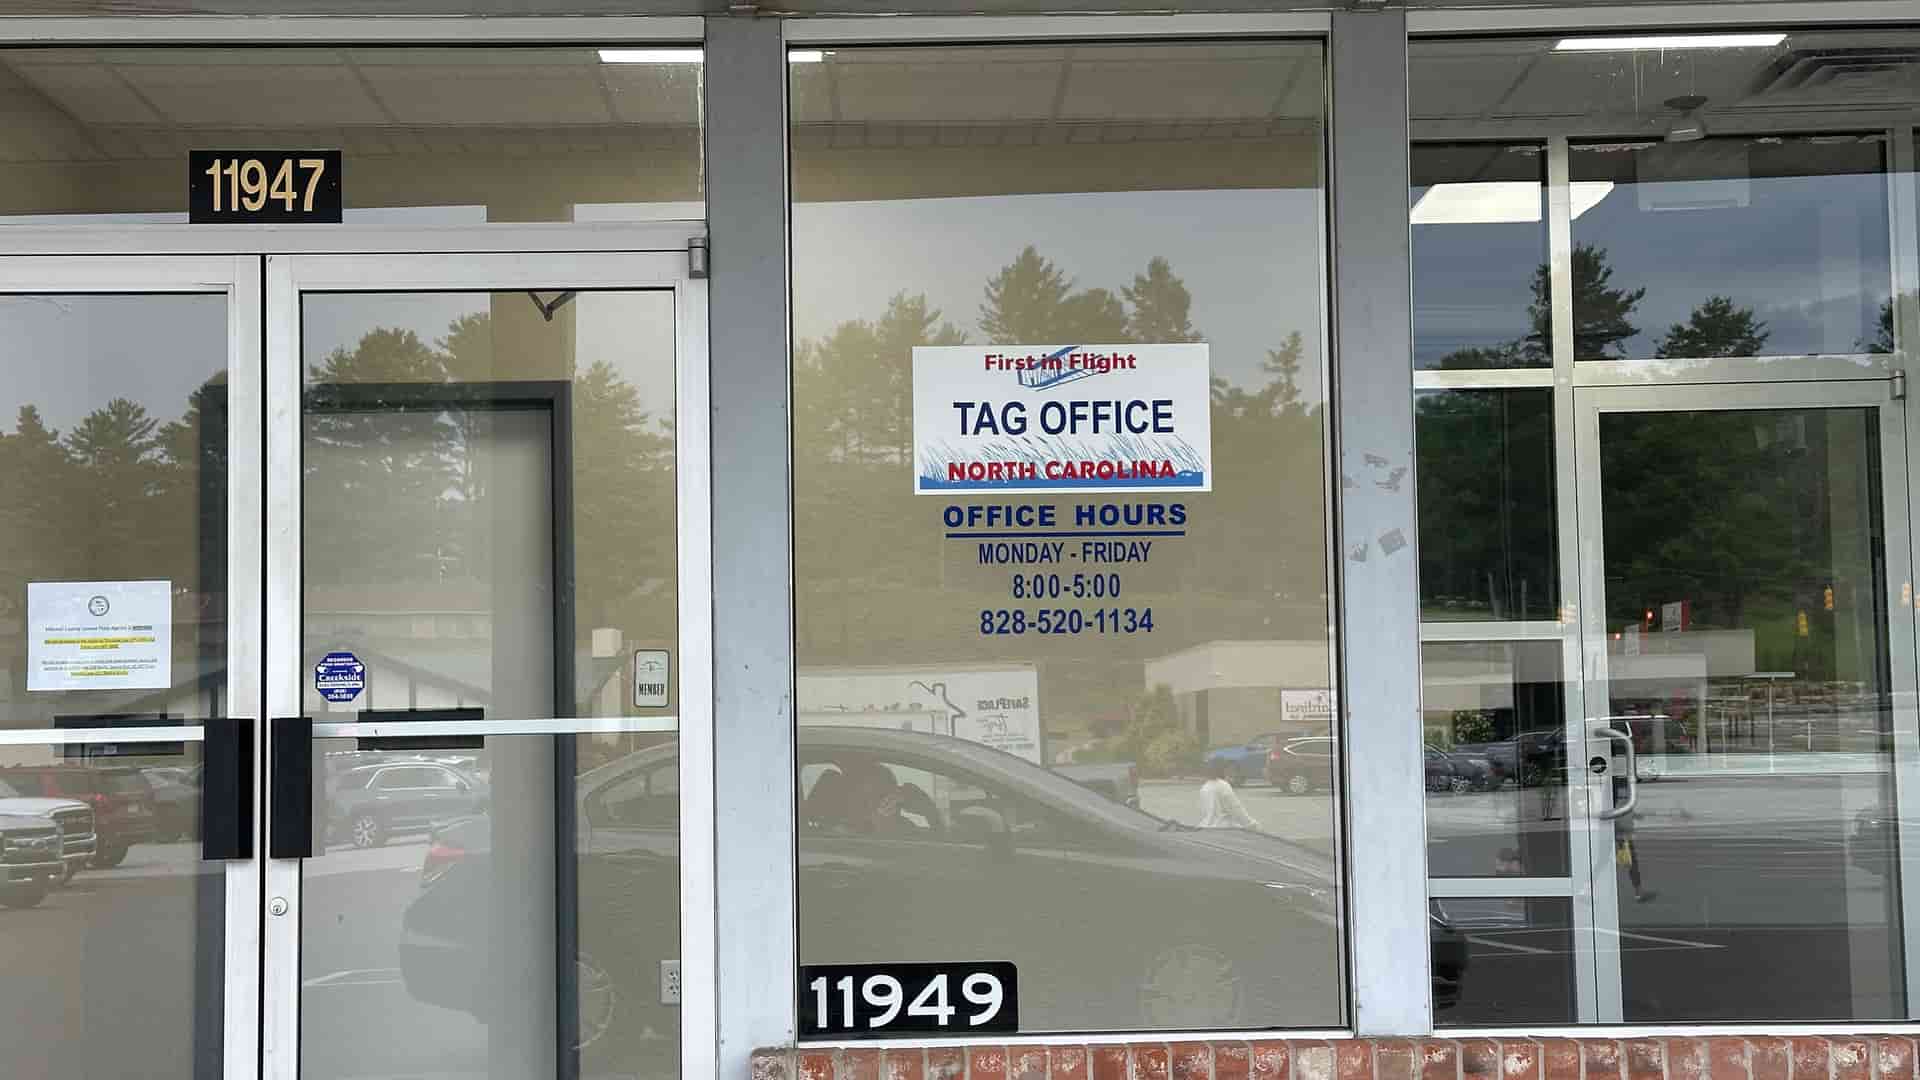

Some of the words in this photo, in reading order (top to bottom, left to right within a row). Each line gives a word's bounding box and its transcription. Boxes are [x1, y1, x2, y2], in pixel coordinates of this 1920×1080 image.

[205, 158, 326, 212] 11947
[984, 354, 1035, 371] First
[1041, 354, 1062, 371] in
[1069, 353, 1137, 373] Flight
[953, 401, 1027, 436] TAG
[1040, 400, 1174, 434] OFFICE
[948, 461, 1036, 481] NORTH
[1045, 460, 1176, 480] CAROLINA
[944, 505, 1057, 528] OFFICE
[1076, 503, 1187, 527] HOURS
[978, 541, 1065, 565] MONDAY
[1082, 540, 1153, 564] FRIDAY
[1012, 573, 1121, 599] 8:00-5:00
[980, 608, 1154, 635] 828-520-1134
[319, 673, 361, 681] Creekside
[639, 683, 665, 696] MEMBER
[809, 972, 1004, 1028] 11949
